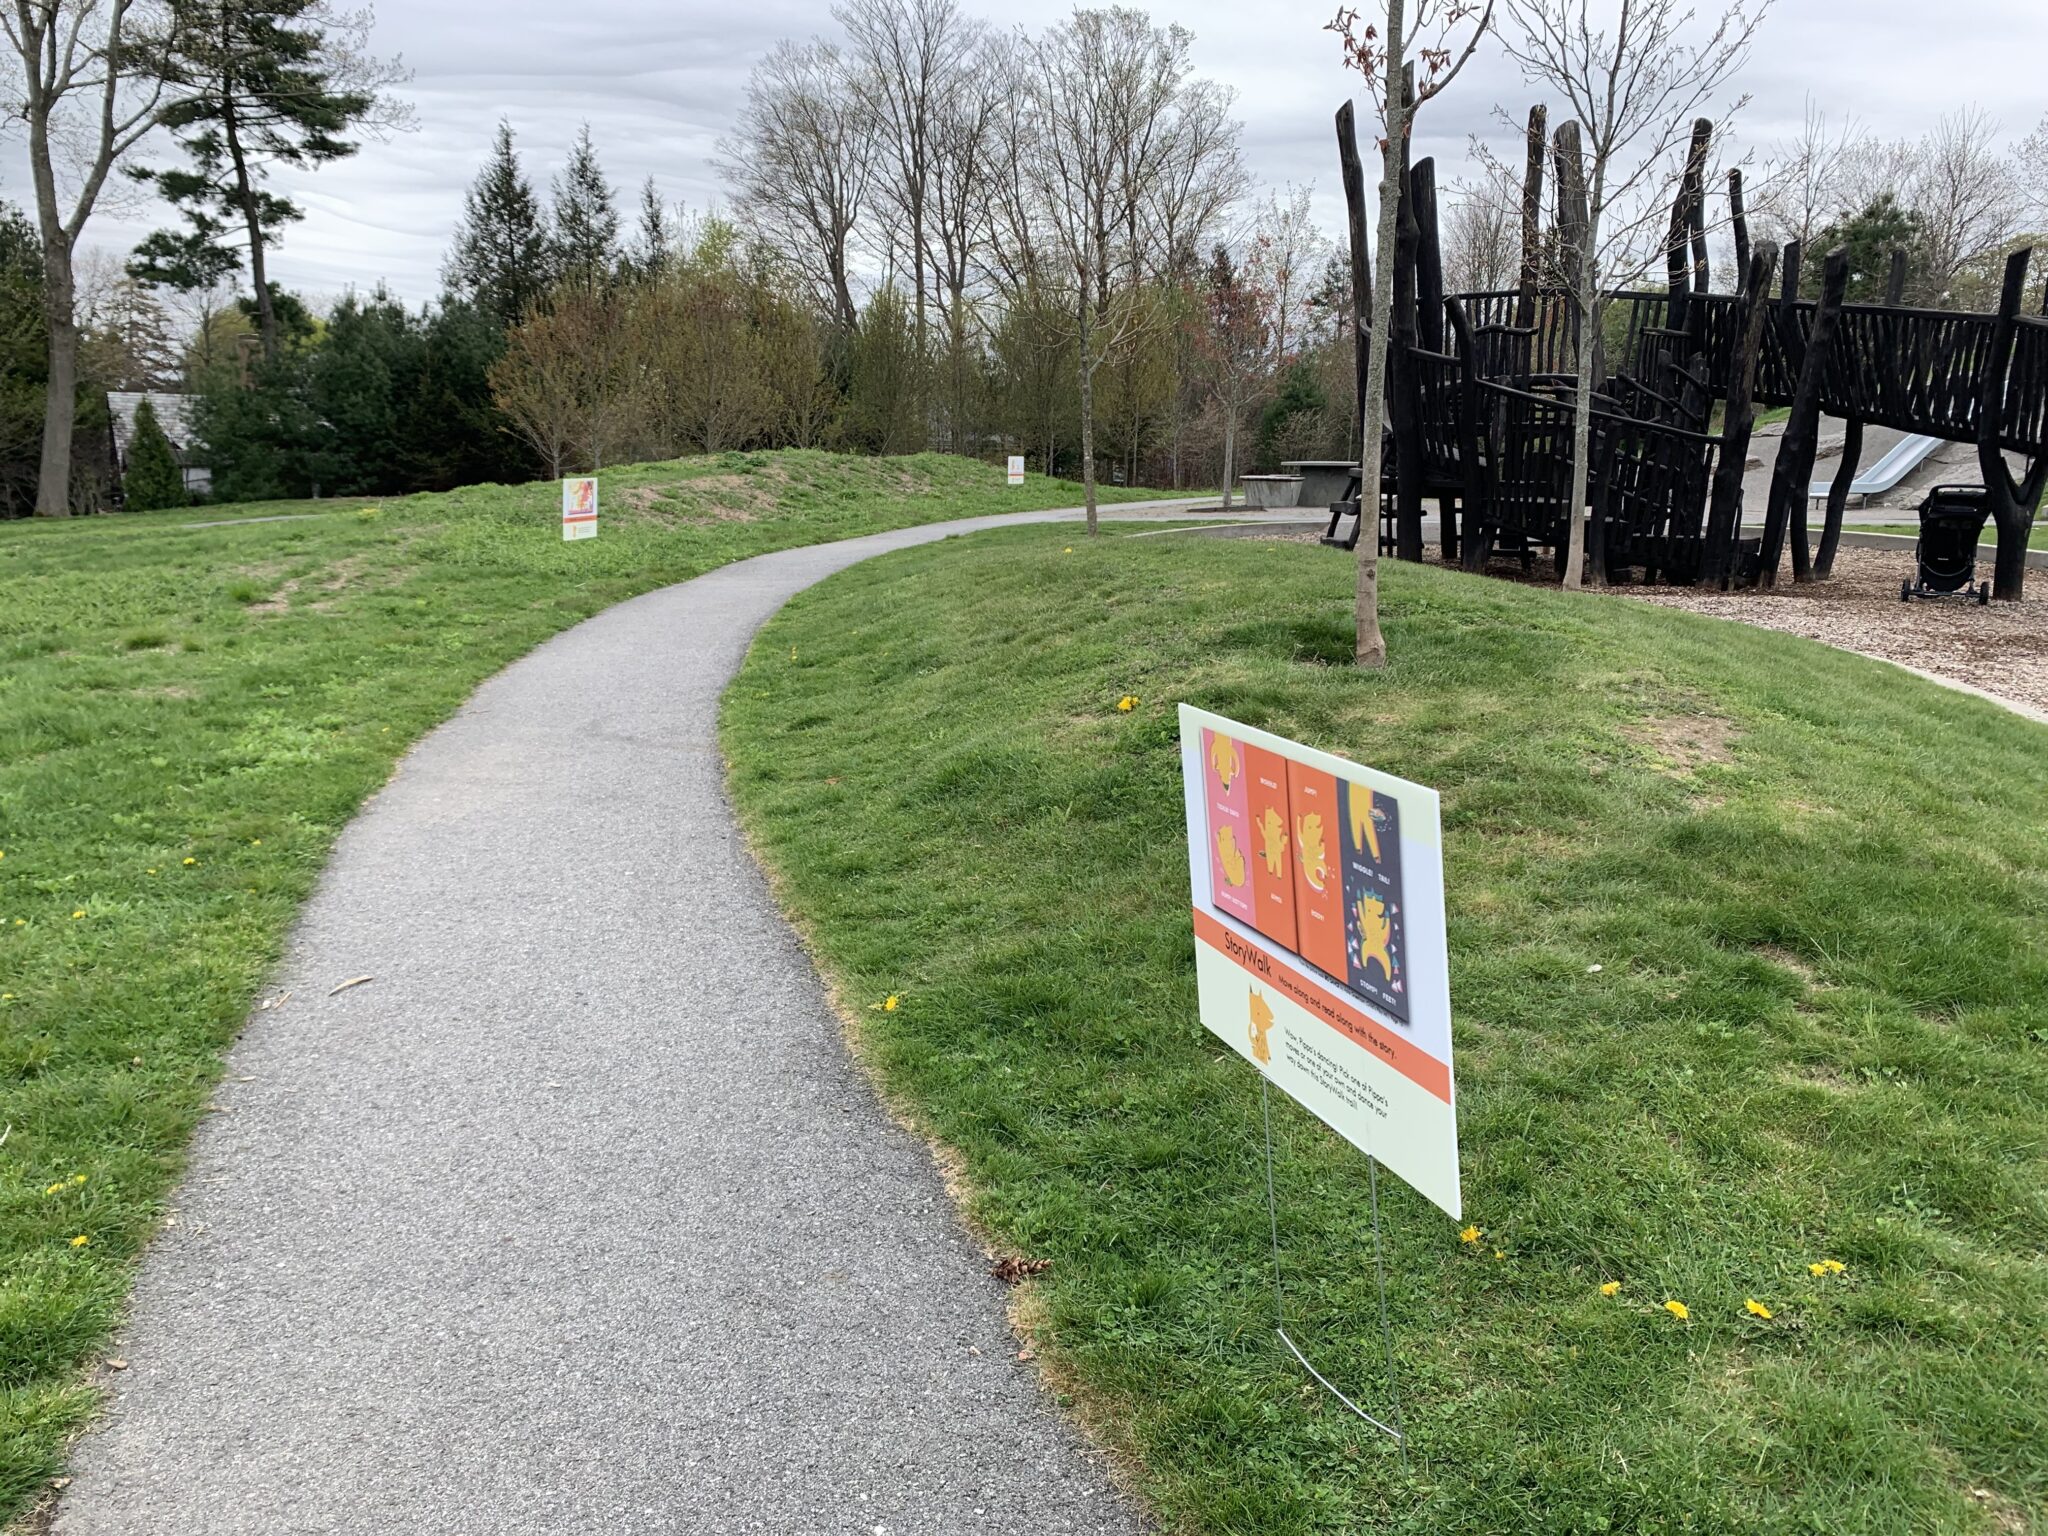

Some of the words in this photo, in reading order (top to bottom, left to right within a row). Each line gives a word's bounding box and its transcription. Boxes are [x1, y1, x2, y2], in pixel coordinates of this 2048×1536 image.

[1225, 931, 1272, 978] StoryWalk
[1278, 975, 1293, 991] Move
[1293, 985, 1309, 1004] along
[1310, 997, 1321, 1009] and
[1322, 1005, 1335, 1019] read
[1336, 1013, 1353, 1033] along
[1354, 1026, 1367, 1039] with
[1368, 1032, 1378, 1047] the
[1285, 1042, 1300, 1056] moves
[1306, 1057, 1316, 1068] one
[1316, 1063, 1322, 1071] of
[1322, 1068, 1334, 1079] your
[1334, 1077, 1345, 1088] own
[1346, 1085, 1357, 1097] and
[1357, 1092, 1374, 1109] dance
[1375, 1106, 1387, 1119] your
[1286, 1054, 1296, 1067] way
[1297, 1060, 1309, 1074] down
[1310, 1069, 1319, 1082] this
[1319, 1075, 1345, 1100] StoryWalk
[1339, 1065, 1349, 1079] Pick
[1350, 1076, 1361, 1088] one
[1361, 1082, 1367, 1091] of
